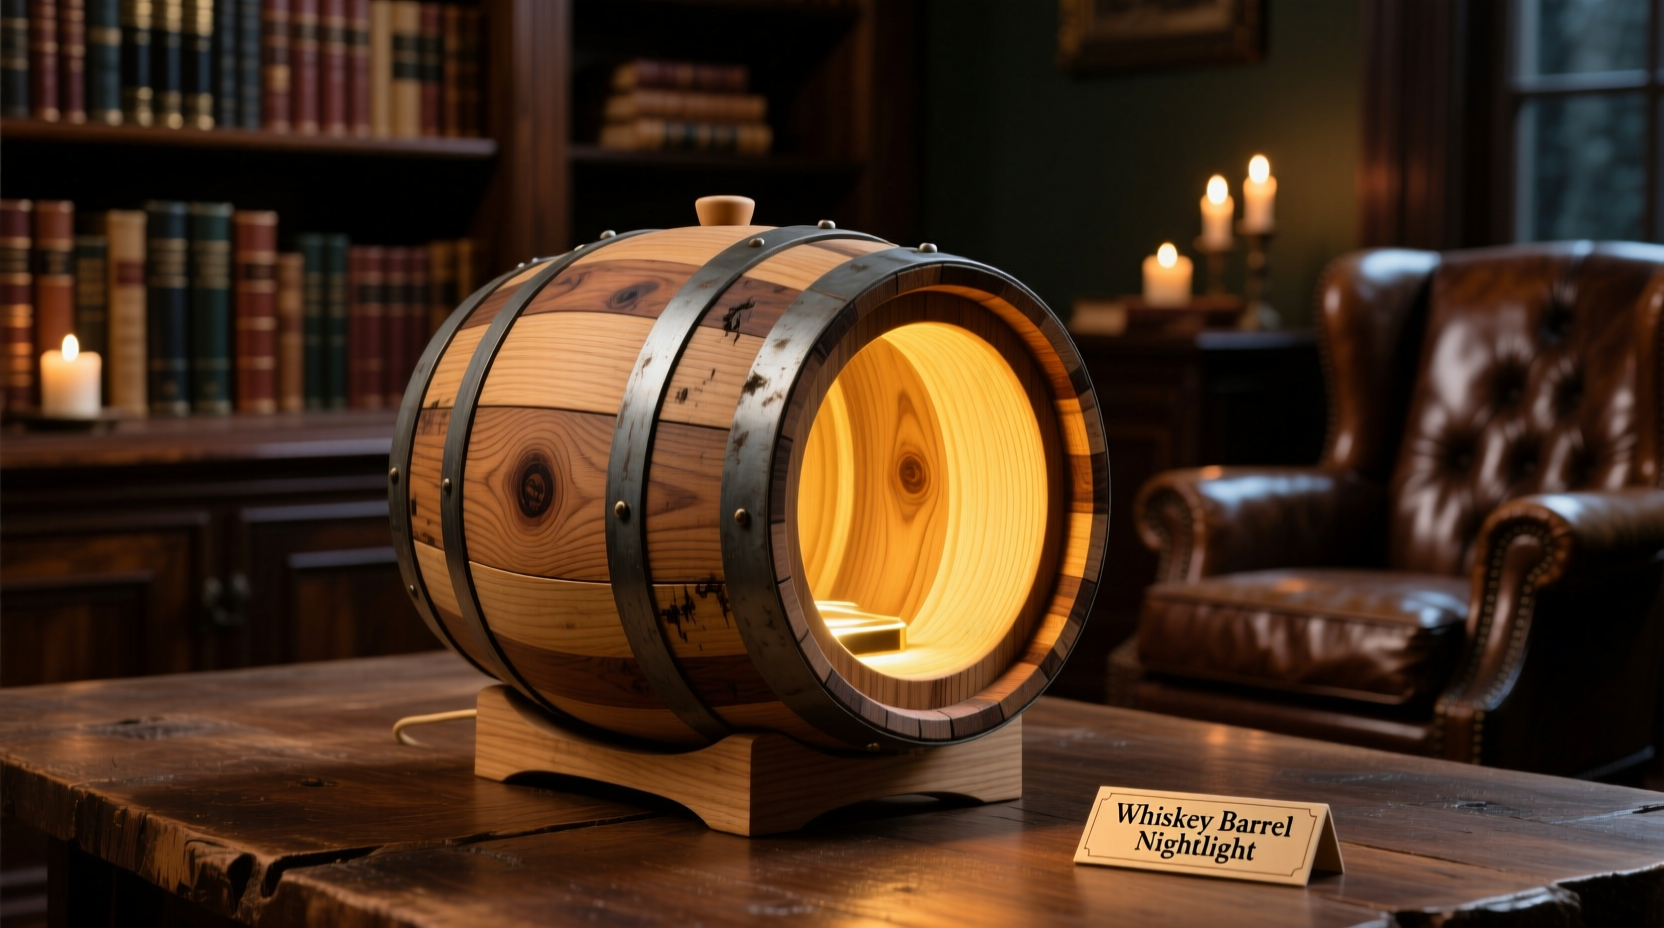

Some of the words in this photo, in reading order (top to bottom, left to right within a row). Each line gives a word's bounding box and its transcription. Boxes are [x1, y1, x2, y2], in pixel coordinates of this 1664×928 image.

[1117, 802, 1214, 836] Whiskey
[1217, 810, 1294, 838] Barrel
[1134, 830, 1257, 864] Nightlight
